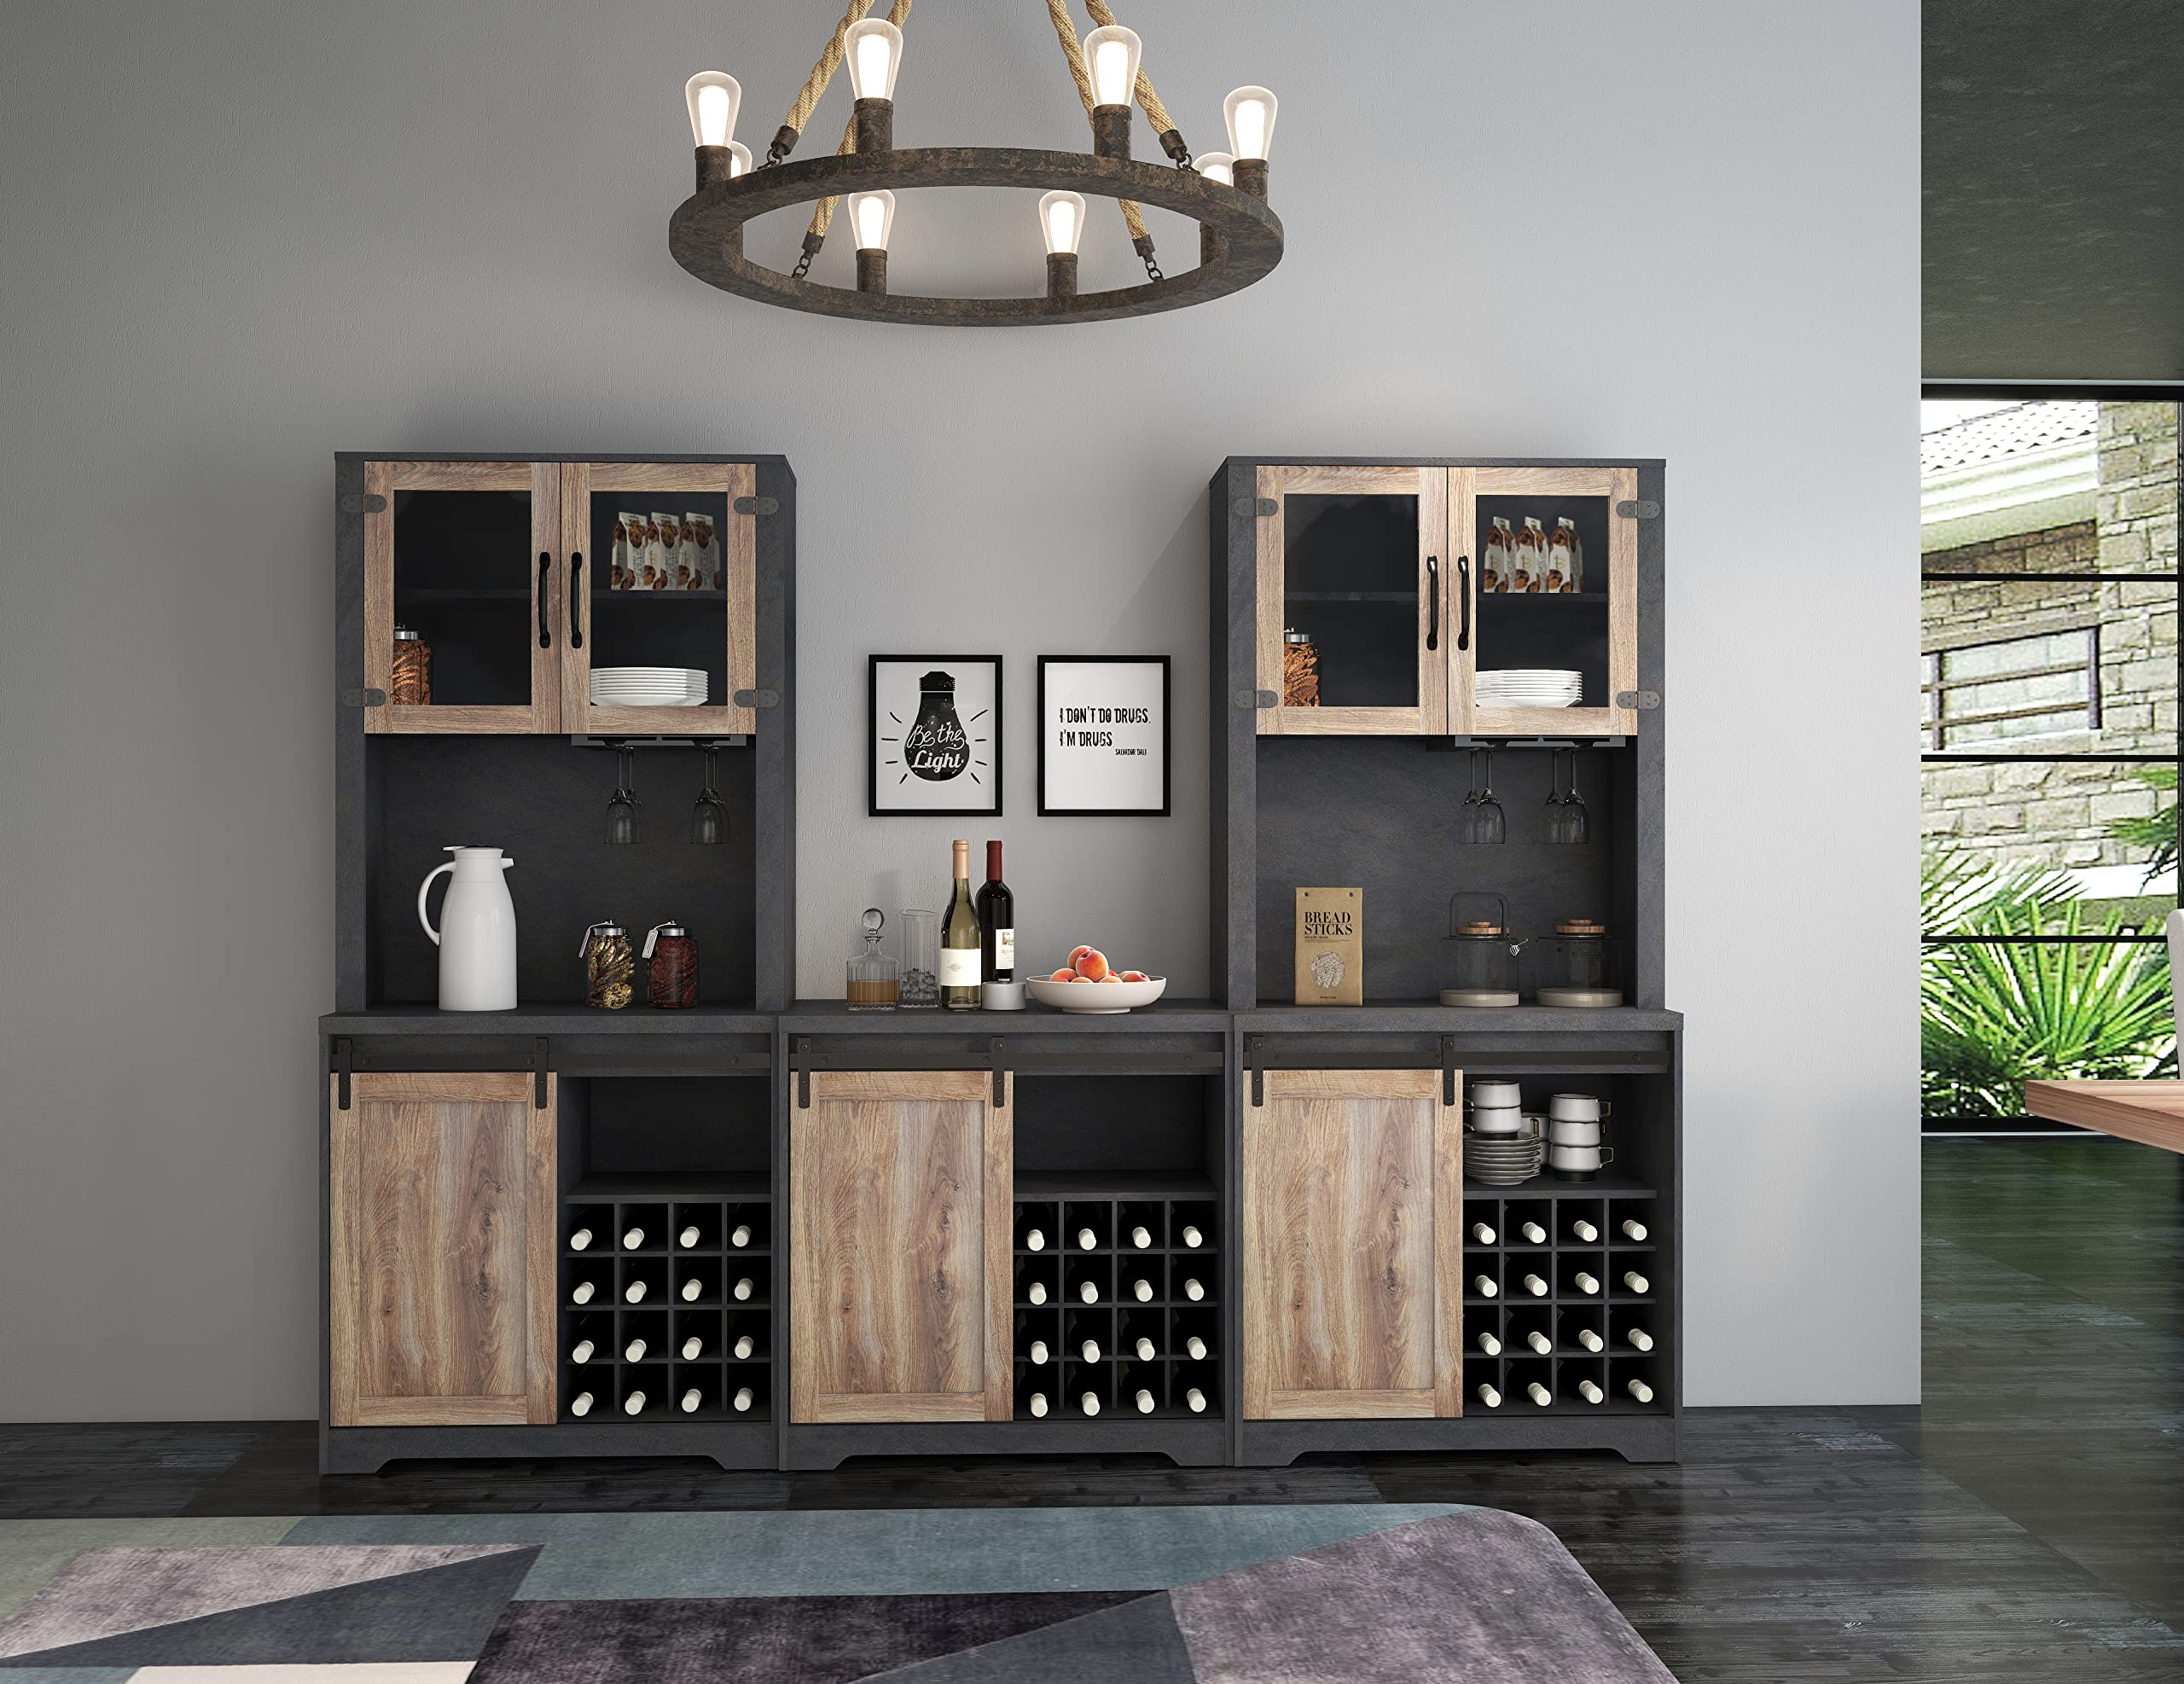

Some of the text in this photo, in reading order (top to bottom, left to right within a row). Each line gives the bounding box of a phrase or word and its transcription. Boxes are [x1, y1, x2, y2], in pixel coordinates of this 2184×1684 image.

[1066, 706, 1096, 723] DON'T
[1097, 707, 1112, 723] DO
[906, 723, 965, 751] Be the
[1059, 729, 1112, 746] I'M DRUGS
[910, 750, 962, 774] Light
[1304, 911, 1351, 924] BREAD
[1304, 923, 1353, 936] STICKS
